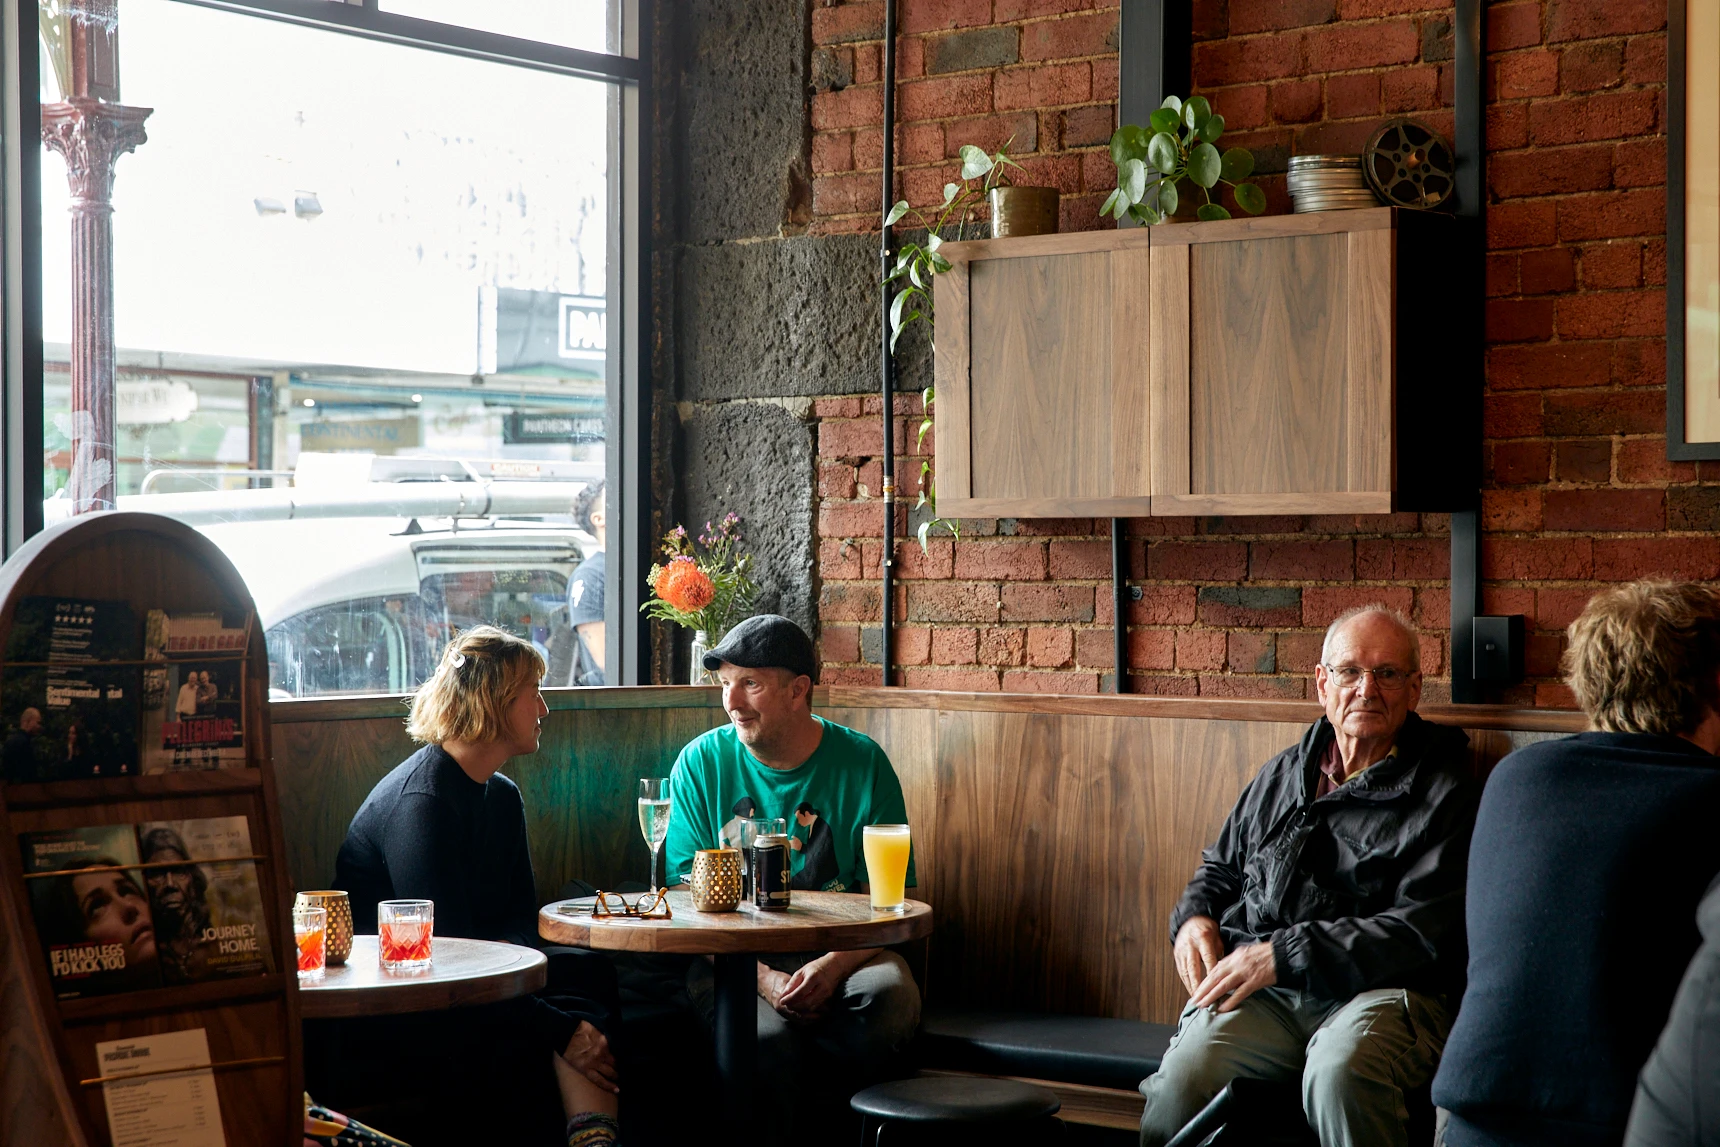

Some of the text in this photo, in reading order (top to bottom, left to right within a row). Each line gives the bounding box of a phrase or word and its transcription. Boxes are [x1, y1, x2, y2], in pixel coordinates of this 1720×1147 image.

[47, 686, 100, 699] Sentimental
[201, 924, 256, 943] JOURNEY
[50, 950, 62, 963] IF
[68, 946, 95, 961] HAD
[95, 943, 125, 958] LEGS
[71, 958, 101, 974] KICK
[101, 955, 126, 971] YOU
